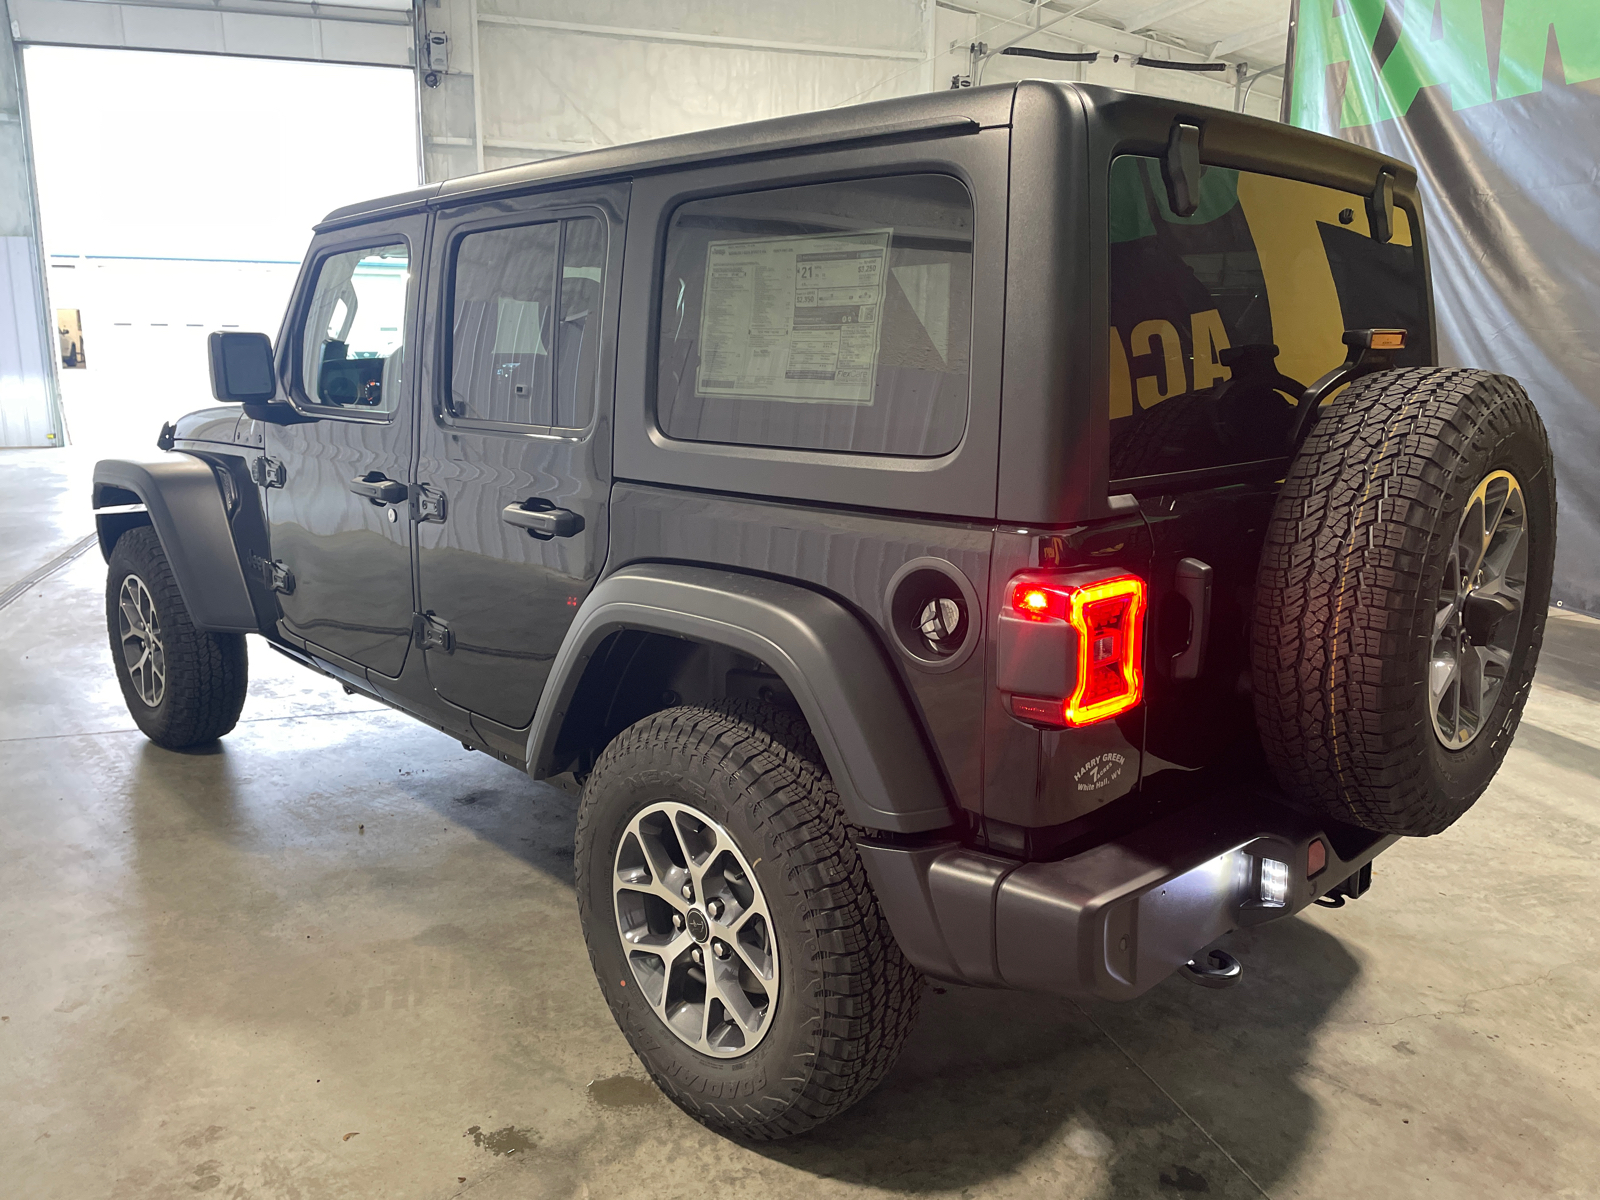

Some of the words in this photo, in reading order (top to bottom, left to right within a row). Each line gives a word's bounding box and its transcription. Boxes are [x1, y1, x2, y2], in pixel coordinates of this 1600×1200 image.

[801, 266, 813, 279] 21
[836, 370, 868, 378] FlexCare
[1074, 756, 1101, 782] HARRY
[1102, 753, 1125, 765] GREEN
[1089, 766, 1098, 783] 7
[1097, 762, 1112, 778] ACRES
[1077, 783, 1095, 791] White
[1096, 778, 1110, 789] Hall,
[1110, 768, 1122, 780] WV
